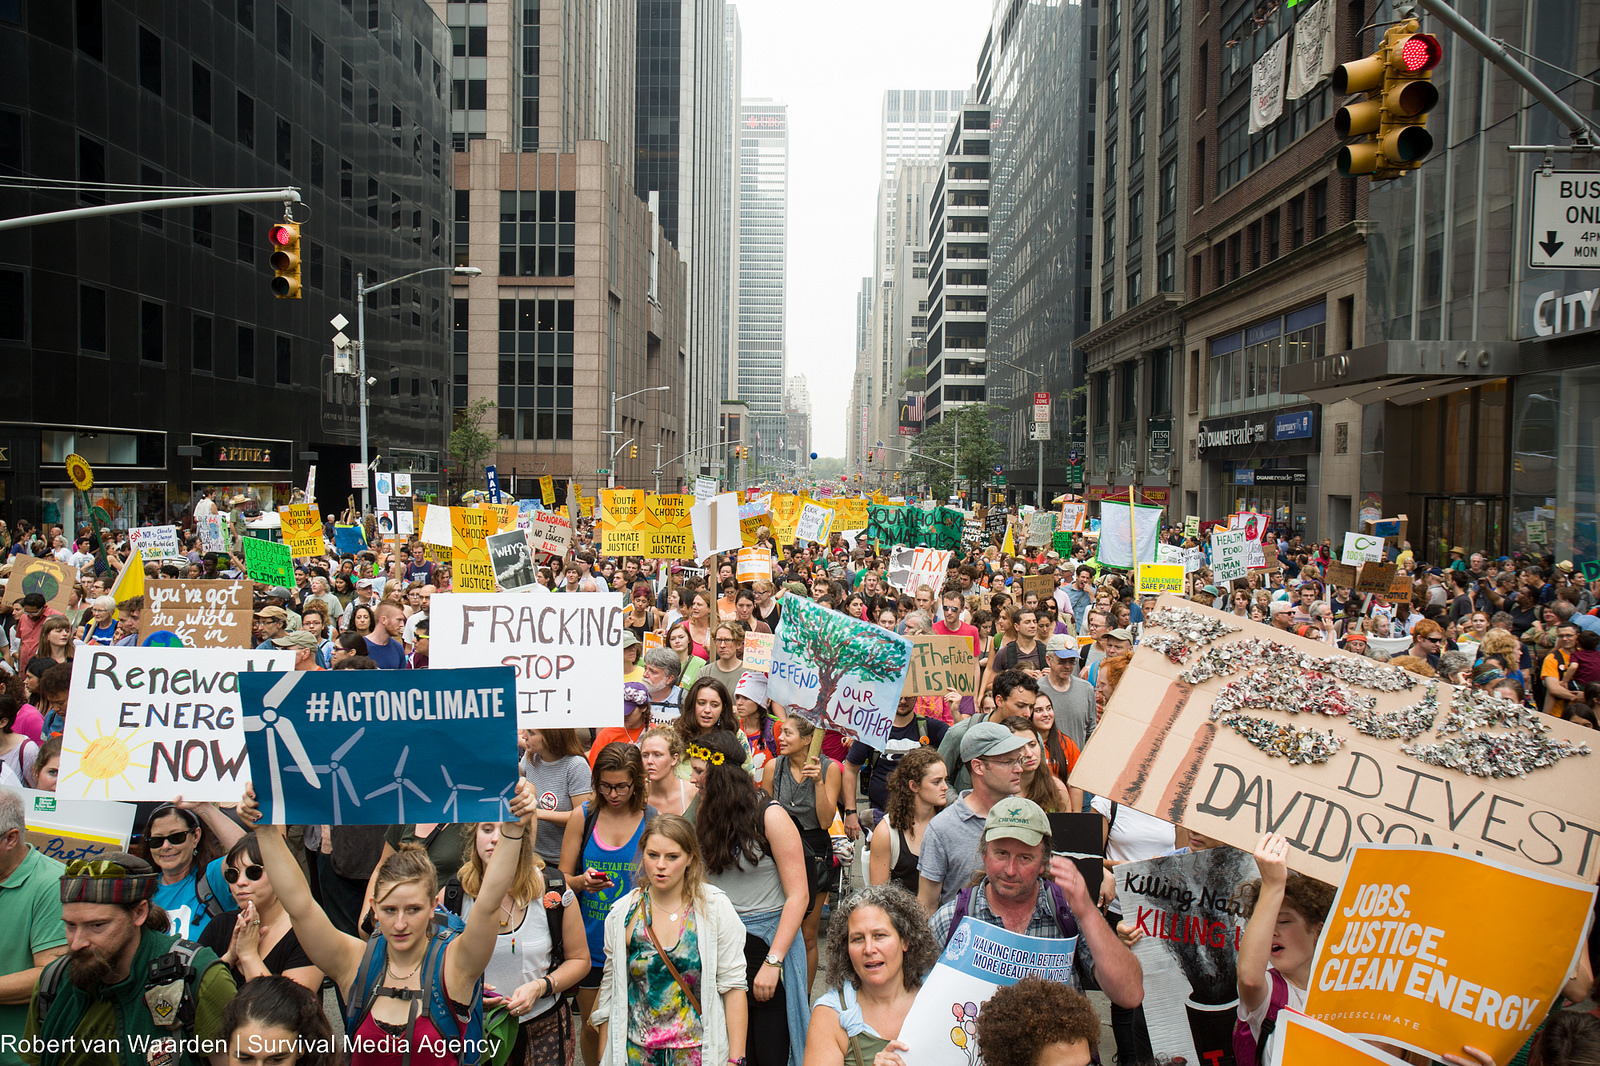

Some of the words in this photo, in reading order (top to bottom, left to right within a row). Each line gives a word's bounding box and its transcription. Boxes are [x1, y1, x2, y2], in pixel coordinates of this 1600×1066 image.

[761, 116, 780, 127] UBS
[1574, 246, 1597, 257] MON
[1533, 288, 1600, 337] CITY
[229, 446, 262, 462] PINK
[487, 471, 498, 504] WATE
[612, 496, 636, 505] YOUTH
[656, 497, 684, 507] YOUTH
[288, 508, 311, 517] YOUTH
[611, 506, 638, 515] CHOOSE
[655, 508, 685, 517] CHOOSE
[288, 518, 313, 526] CHOOSE
[461, 514, 488, 526] YOUTH
[742, 515, 763, 527] YOUTH
[461, 528, 490, 540] CHOOSE
[534, 529, 542, 538] NO
[548, 525, 556, 533] IS
[290, 538, 317, 548] CLIMATE
[545, 533, 564, 544] LONGER
[608, 532, 639, 542] CLIMATE
[651, 535, 686, 544] CLIMATE
[1216, 532, 1244, 546] HEALTHY
[606, 542, 639, 552] JUSTICE!
[650, 545, 685, 555] JUSTICE!
[1222, 545, 1243, 556] FOOD
[912, 548, 948, 572] TAX
[1346, 550, 1365, 562] 100%
[460, 563, 493, 577] CLIMATE
[1214, 560, 1240, 572] HUMAN
[1221, 566, 1246, 580] RIGHTS
[249, 570, 287, 587] CLIMATE
[459, 577, 493, 591] JUSTICE!
[1141, 576, 1161, 584] CLEAN
[1161, 577, 1183, 585] ENERGY
[1140, 582, 1158, 590] SAFE
[1159, 583, 1182, 591] PLANET
[149, 583, 203, 613] you've
[205, 580, 243, 617] got
[150, 612, 175, 626] the
[186, 604, 237, 626] whole
[461, 604, 623, 647] FRACKING
[758, 639, 773, 648] the
[746, 647, 765, 656] we
[501, 654, 575, 680] STOP
[772, 661, 818, 690] DEFEND
[945, 670, 975, 692] NOW
[843, 686, 875, 707] OUR
[306, 687, 505, 723] #ACTONCLIMATE
[119, 702, 235, 730] ENERG
[833, 700, 893, 744] MOTHER
[148, 739, 248, 783] NOW
[1337, 751, 1600, 877] DIVEST
[585, 859, 622, 871] WESLEYAN
[1124, 871, 1197, 913] Killing
[1343, 883, 1411, 919] JOBS.
[1136, 905, 1226, 949] KILLING
[972, 935, 1010, 961] WALKING
[1010, 948, 1029, 964] FOR
[1029, 953, 1036, 966] A
[1037, 953, 1066, 968] BETTER
[1331, 921, 1448, 968] JUSTICE.
[972, 953, 998, 973] MORE
[1047, 968, 1072, 982] WORLD
[1318, 958, 1404, 992] CLEAN
[1403, 961, 1541, 1032] ENERGY.
